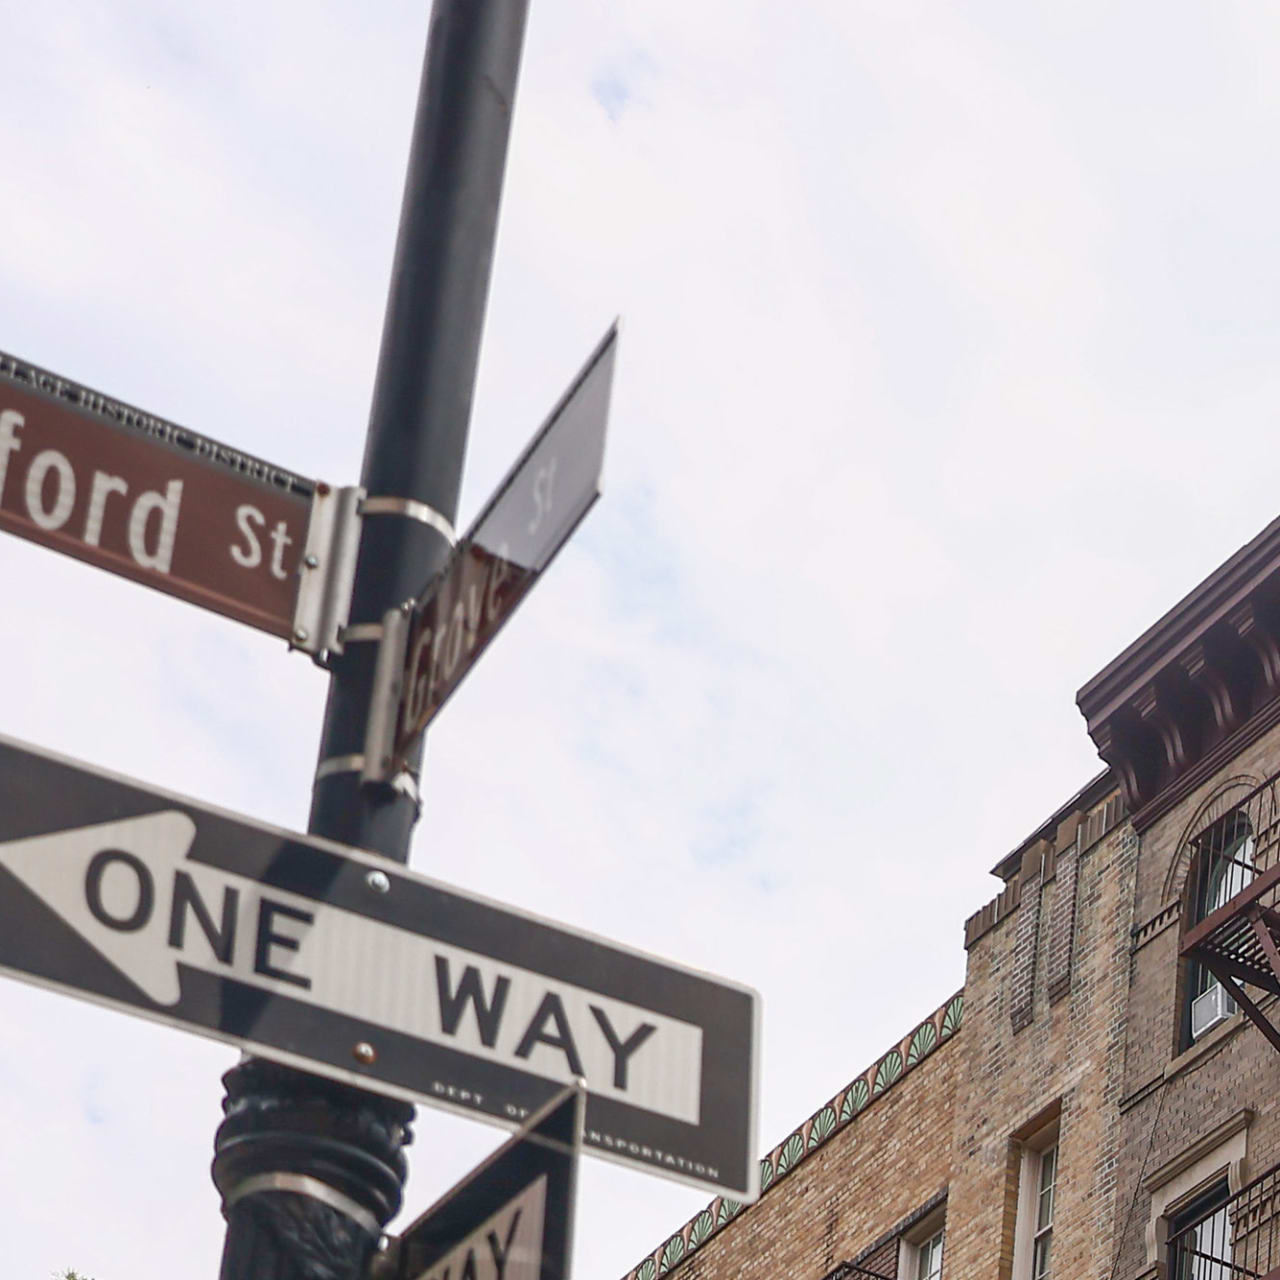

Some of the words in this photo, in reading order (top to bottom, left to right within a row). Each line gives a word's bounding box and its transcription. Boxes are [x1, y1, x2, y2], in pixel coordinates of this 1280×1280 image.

[0, 408, 184, 575] ford
[229, 504, 292, 580] St
[79, 389, 189, 447] HISTORIC
[196, 436, 299, 493] DISTRICT
[404, 543, 512, 735] Grove
[527, 455, 559, 536] St
[84, 848, 315, 992] ONE
[433, 954, 658, 1091] WAY
[432, 1081, 482, 1105] DEPT
[505, 1103, 529, 1119] OF
[581, 1128, 719, 1179] NSPORTATION
